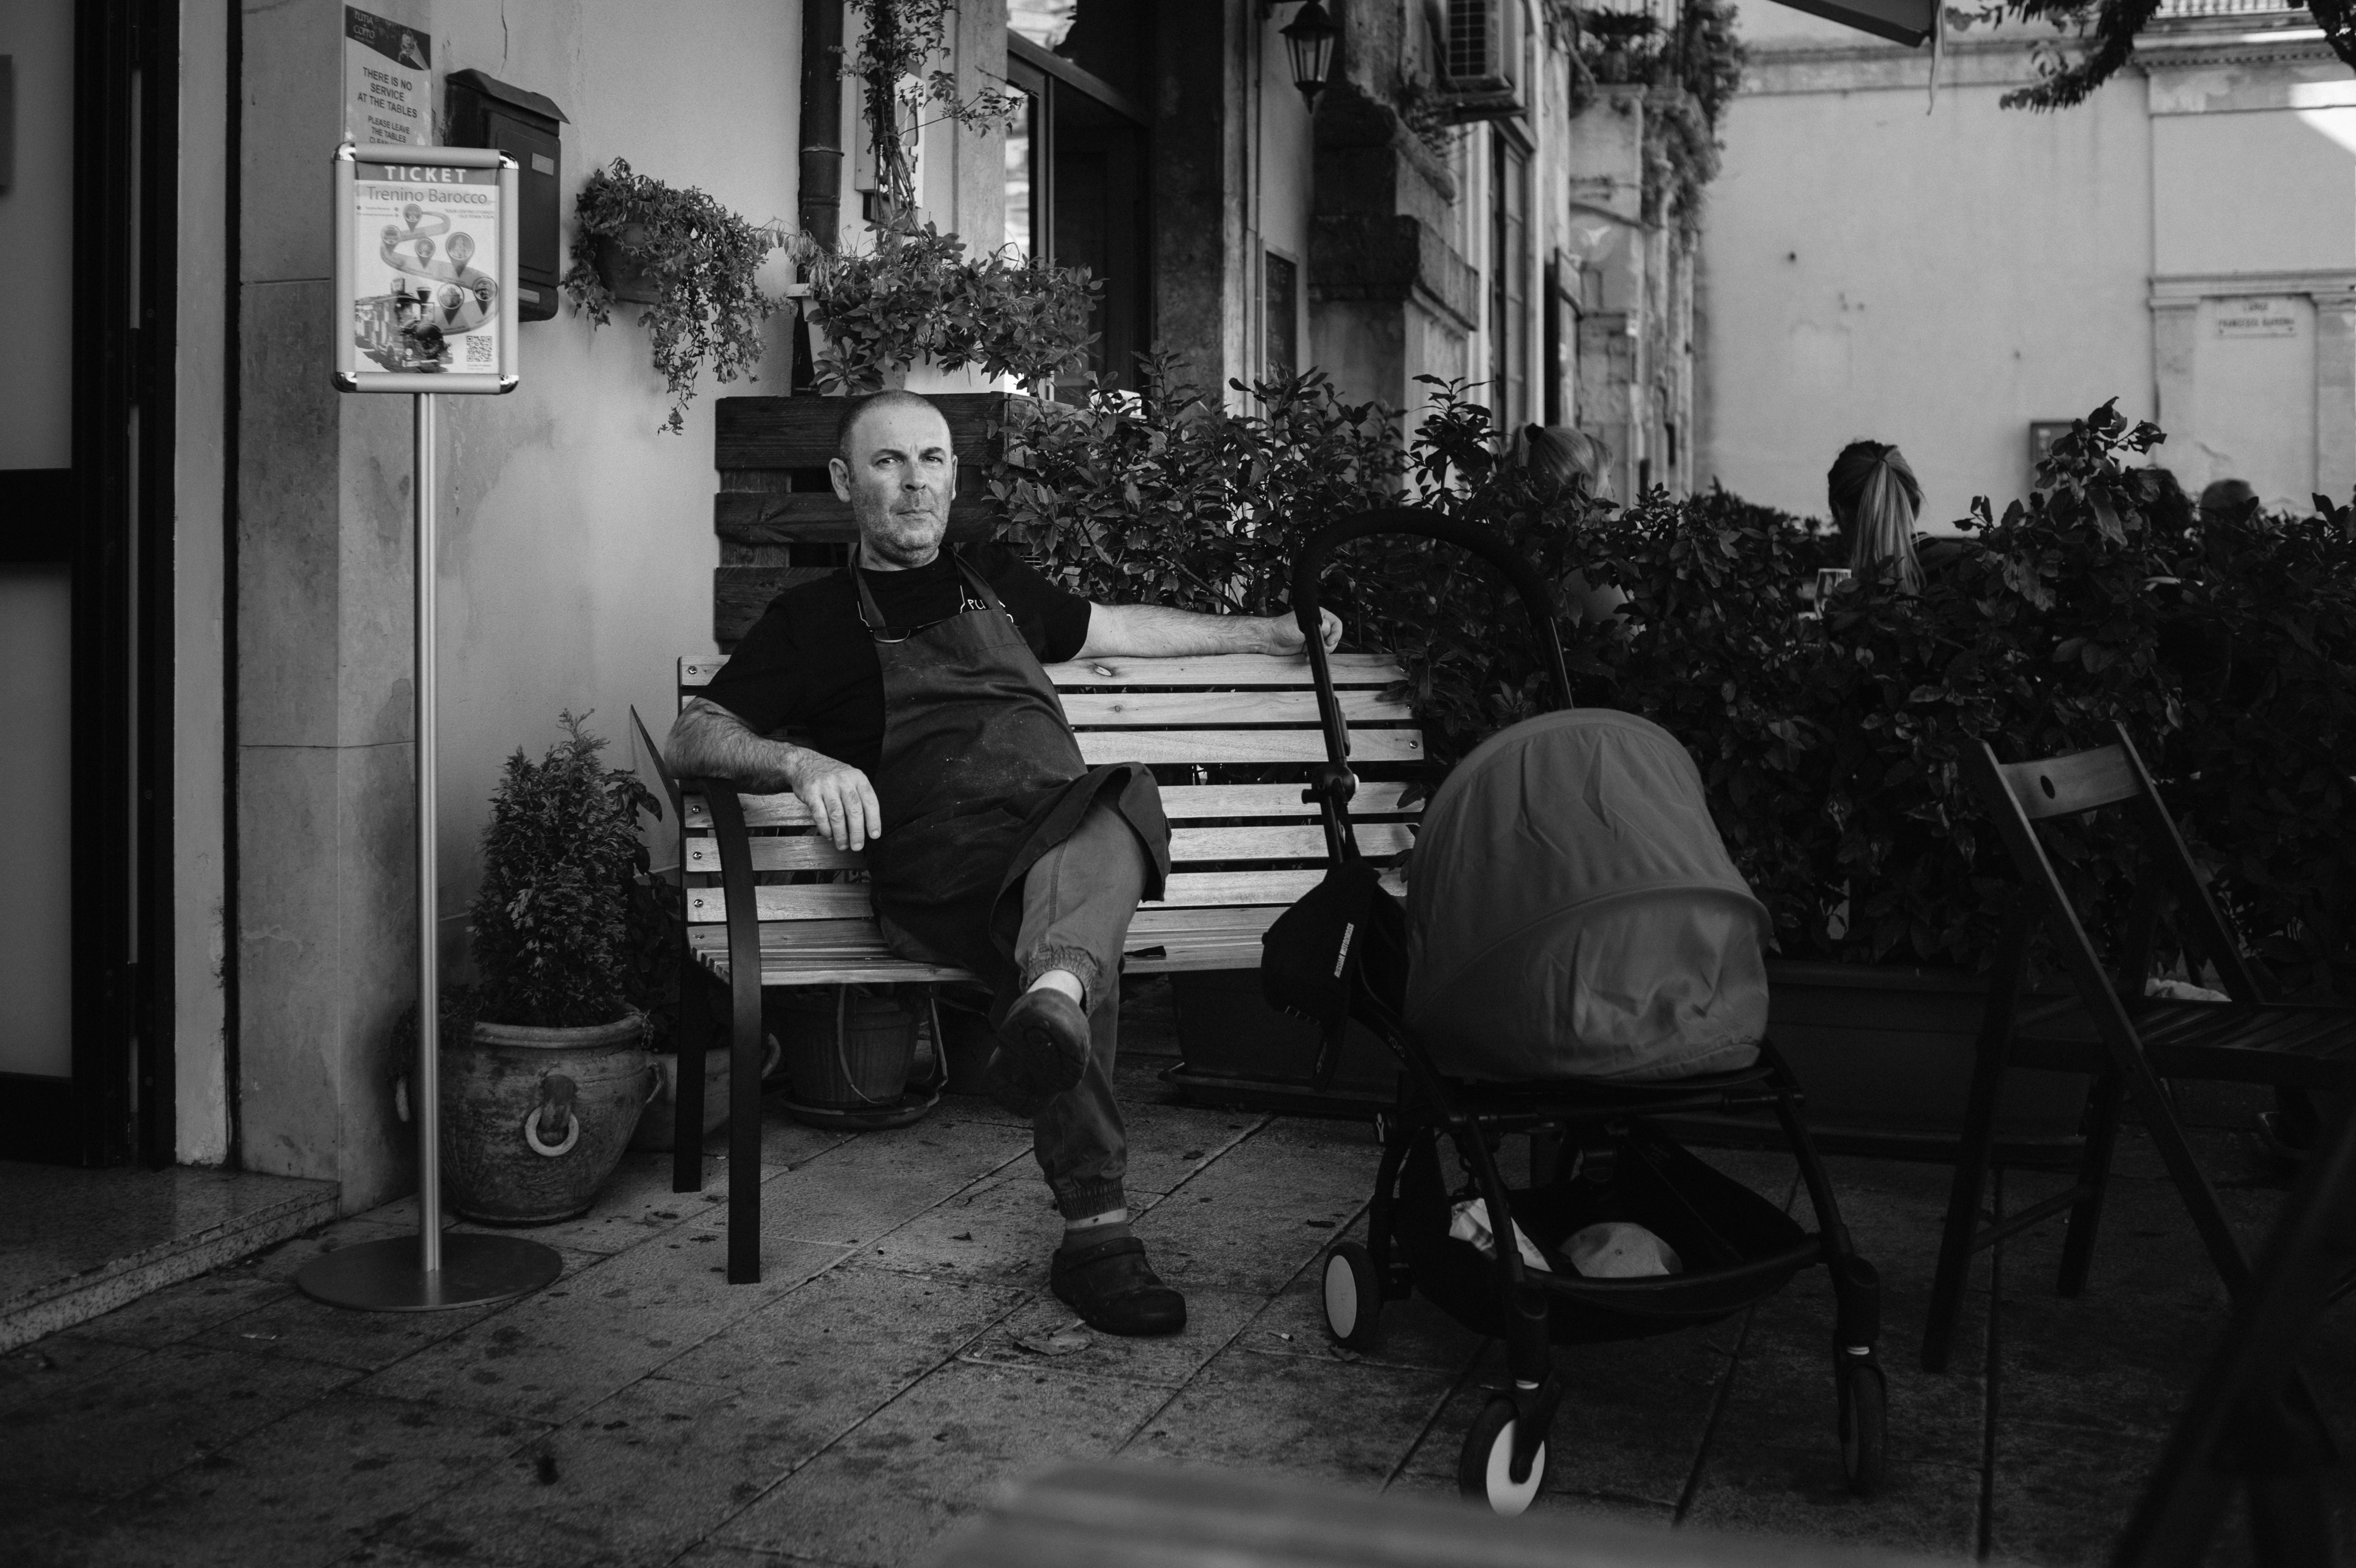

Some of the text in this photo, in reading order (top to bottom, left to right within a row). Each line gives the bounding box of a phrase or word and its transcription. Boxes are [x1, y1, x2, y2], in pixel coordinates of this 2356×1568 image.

[363, 67, 412, 91] THERE IS NO
[370, 83, 404, 102] SERVICE
[357, 92, 418, 118] AT THE TABLES
[368, 115, 410, 135] PLEASE LEAVE
[371, 126, 406, 143] THE TABLES
[384, 165, 466, 183] TICKET
[366, 185, 487, 204] Trenino Barocco
[1334, 922, 1354, 978] RUSSIAN MOTOCROSS
